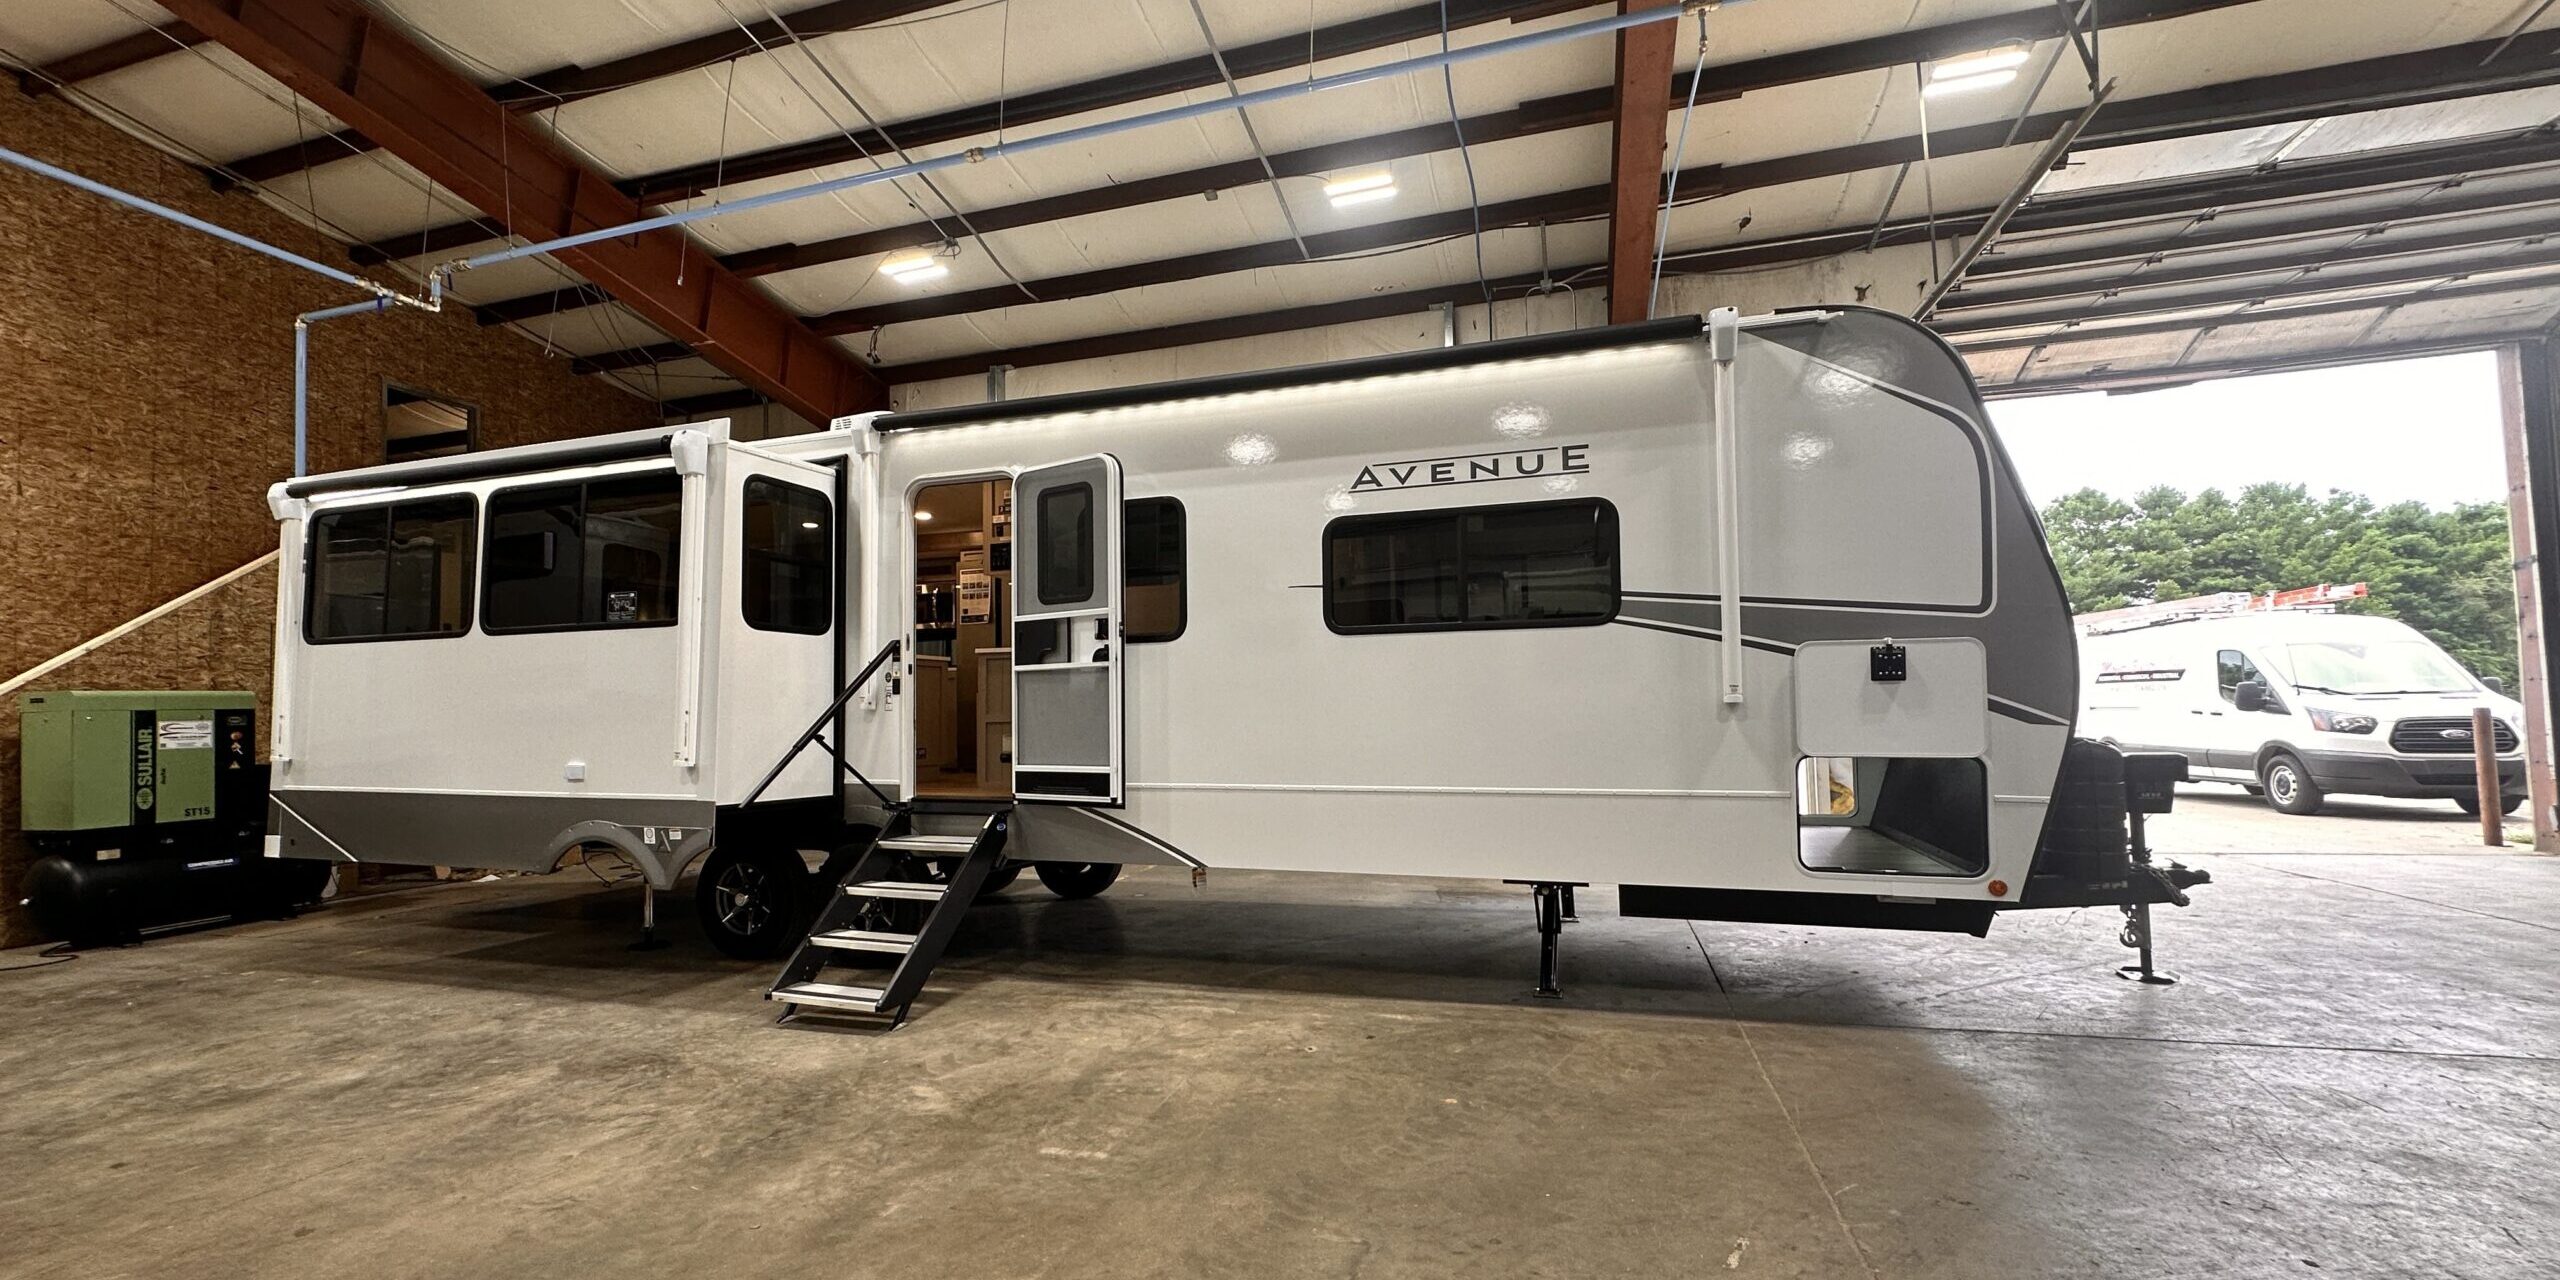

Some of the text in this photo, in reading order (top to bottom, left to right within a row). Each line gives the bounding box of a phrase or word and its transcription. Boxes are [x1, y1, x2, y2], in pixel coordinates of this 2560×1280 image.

[1350, 443, 1590, 490] AVENUE
[137, 728, 153, 786] SULLAIR
[184, 806, 211, 817] ST15
